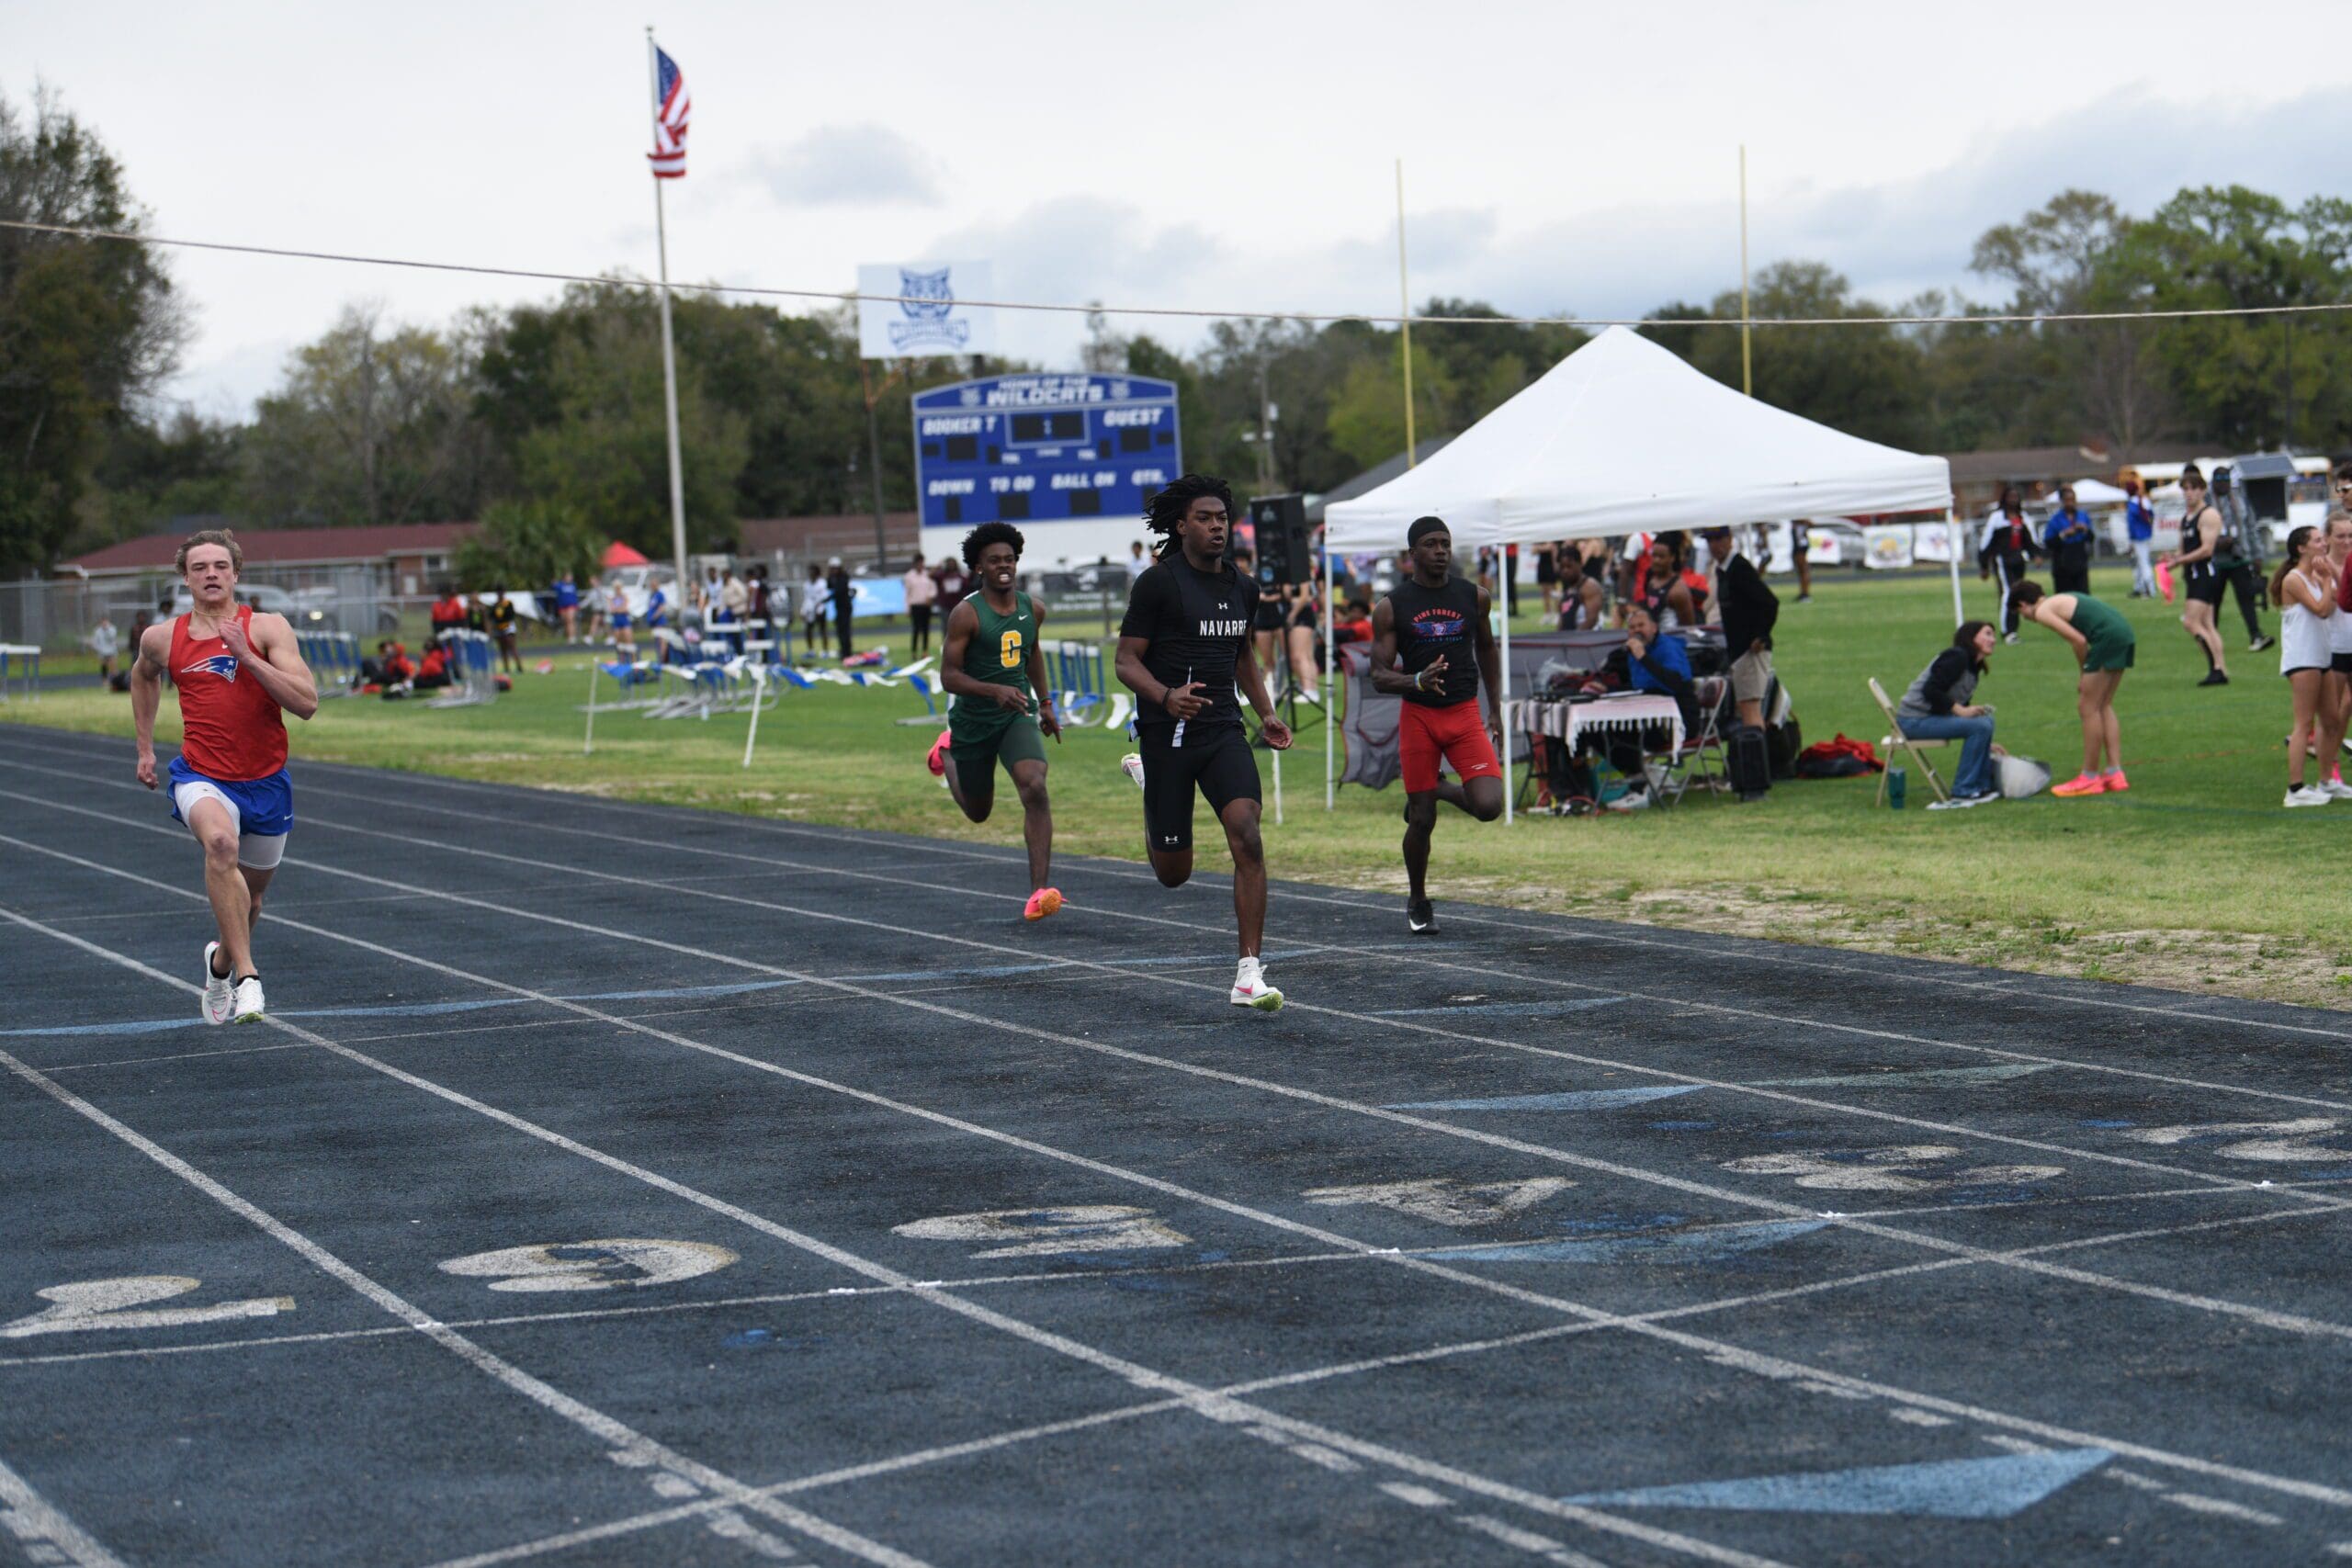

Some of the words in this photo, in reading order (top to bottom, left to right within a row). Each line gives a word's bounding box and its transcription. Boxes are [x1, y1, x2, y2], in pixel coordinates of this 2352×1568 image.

[987, 385, 1102, 406] WILDCATS
[922, 417, 981, 435] BOOKER
[985, 416, 998, 434] T
[1102, 407, 1163, 427] GUEST
[928, 478, 976, 496] DOWN
[989, 476, 1010, 492] TO
[1012, 475, 1035, 491] GO
[1050, 472, 1090, 490] BALL
[1093, 470, 1116, 488] ON
[1413, 610, 1430, 623] PINE
[1432, 608, 1462, 619] FOREST
[1001, 630, 1022, 668] C
